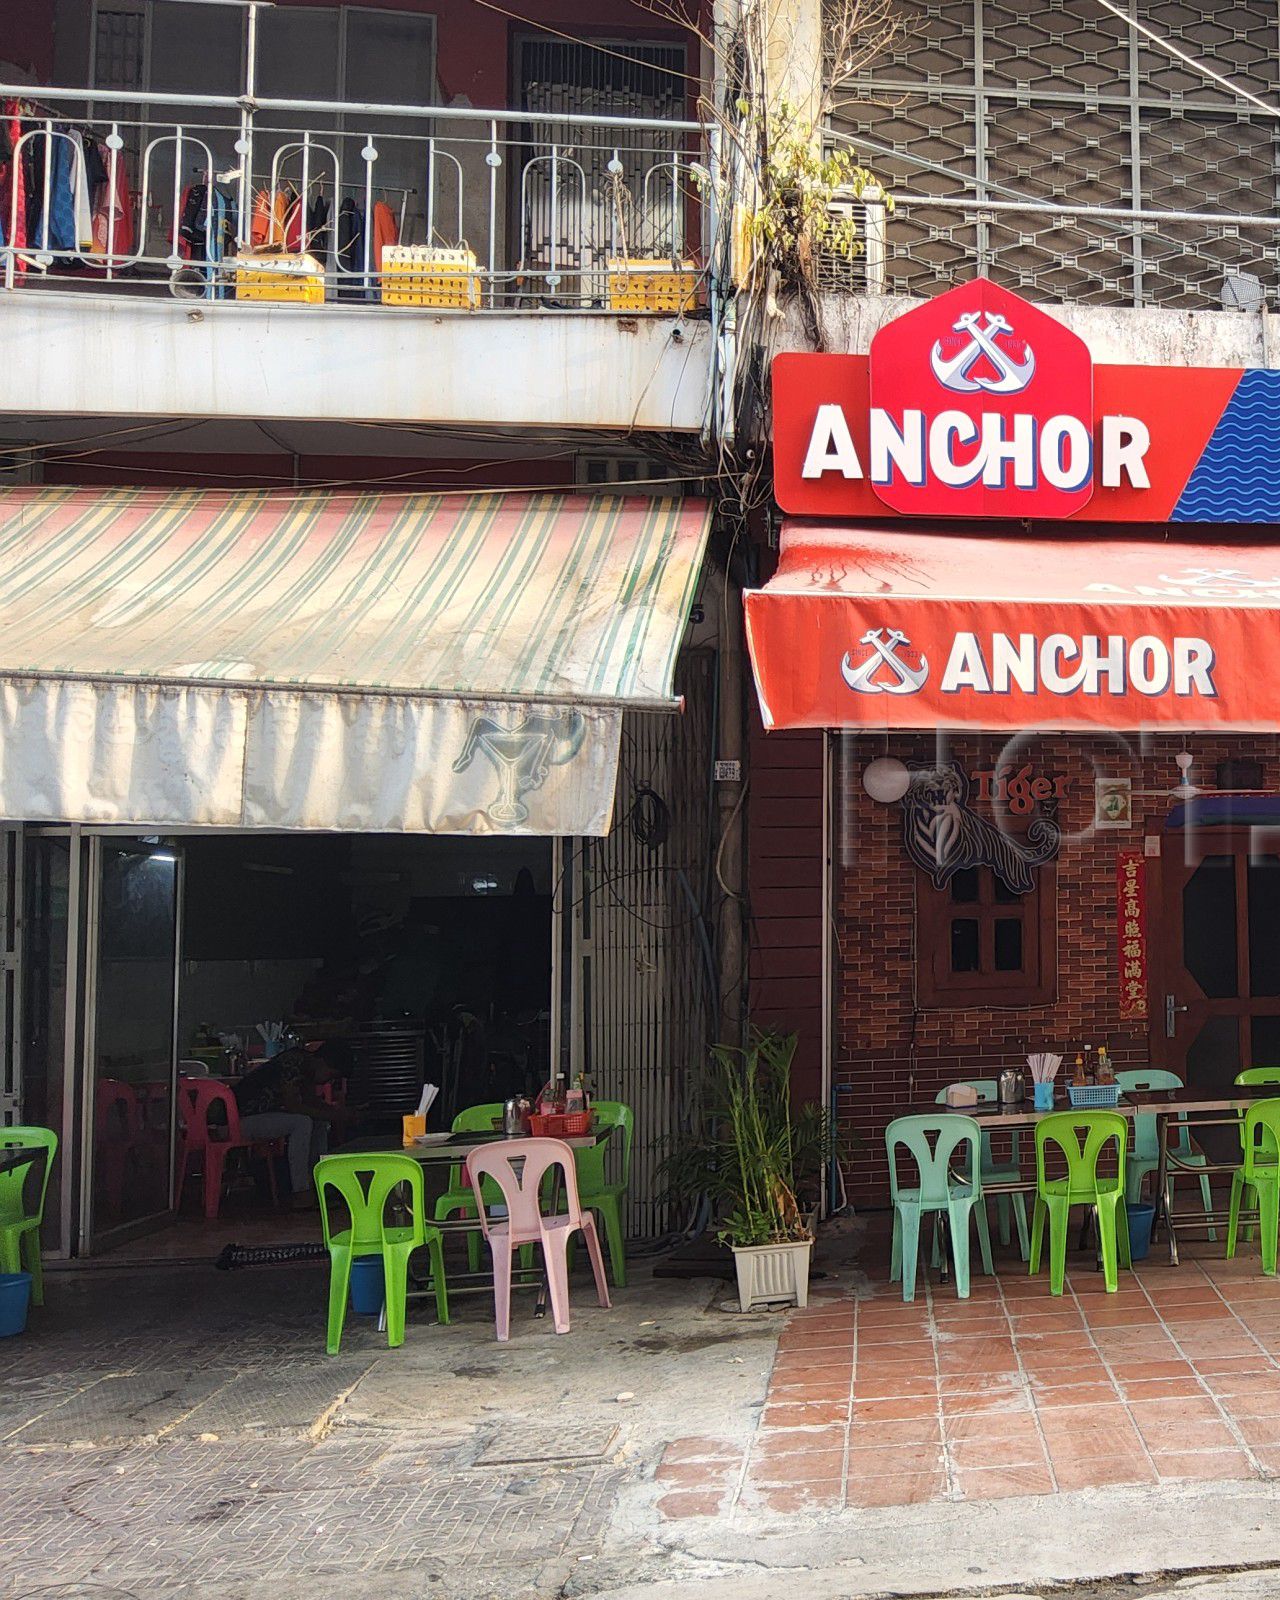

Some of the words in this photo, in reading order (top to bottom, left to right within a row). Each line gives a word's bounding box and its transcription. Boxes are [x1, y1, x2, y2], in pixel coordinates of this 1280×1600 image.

[801, 403, 1151, 490] ANCHOR
[940, 632, 1219, 697] ANCHOR
[971, 762, 1073, 815] Tiger
